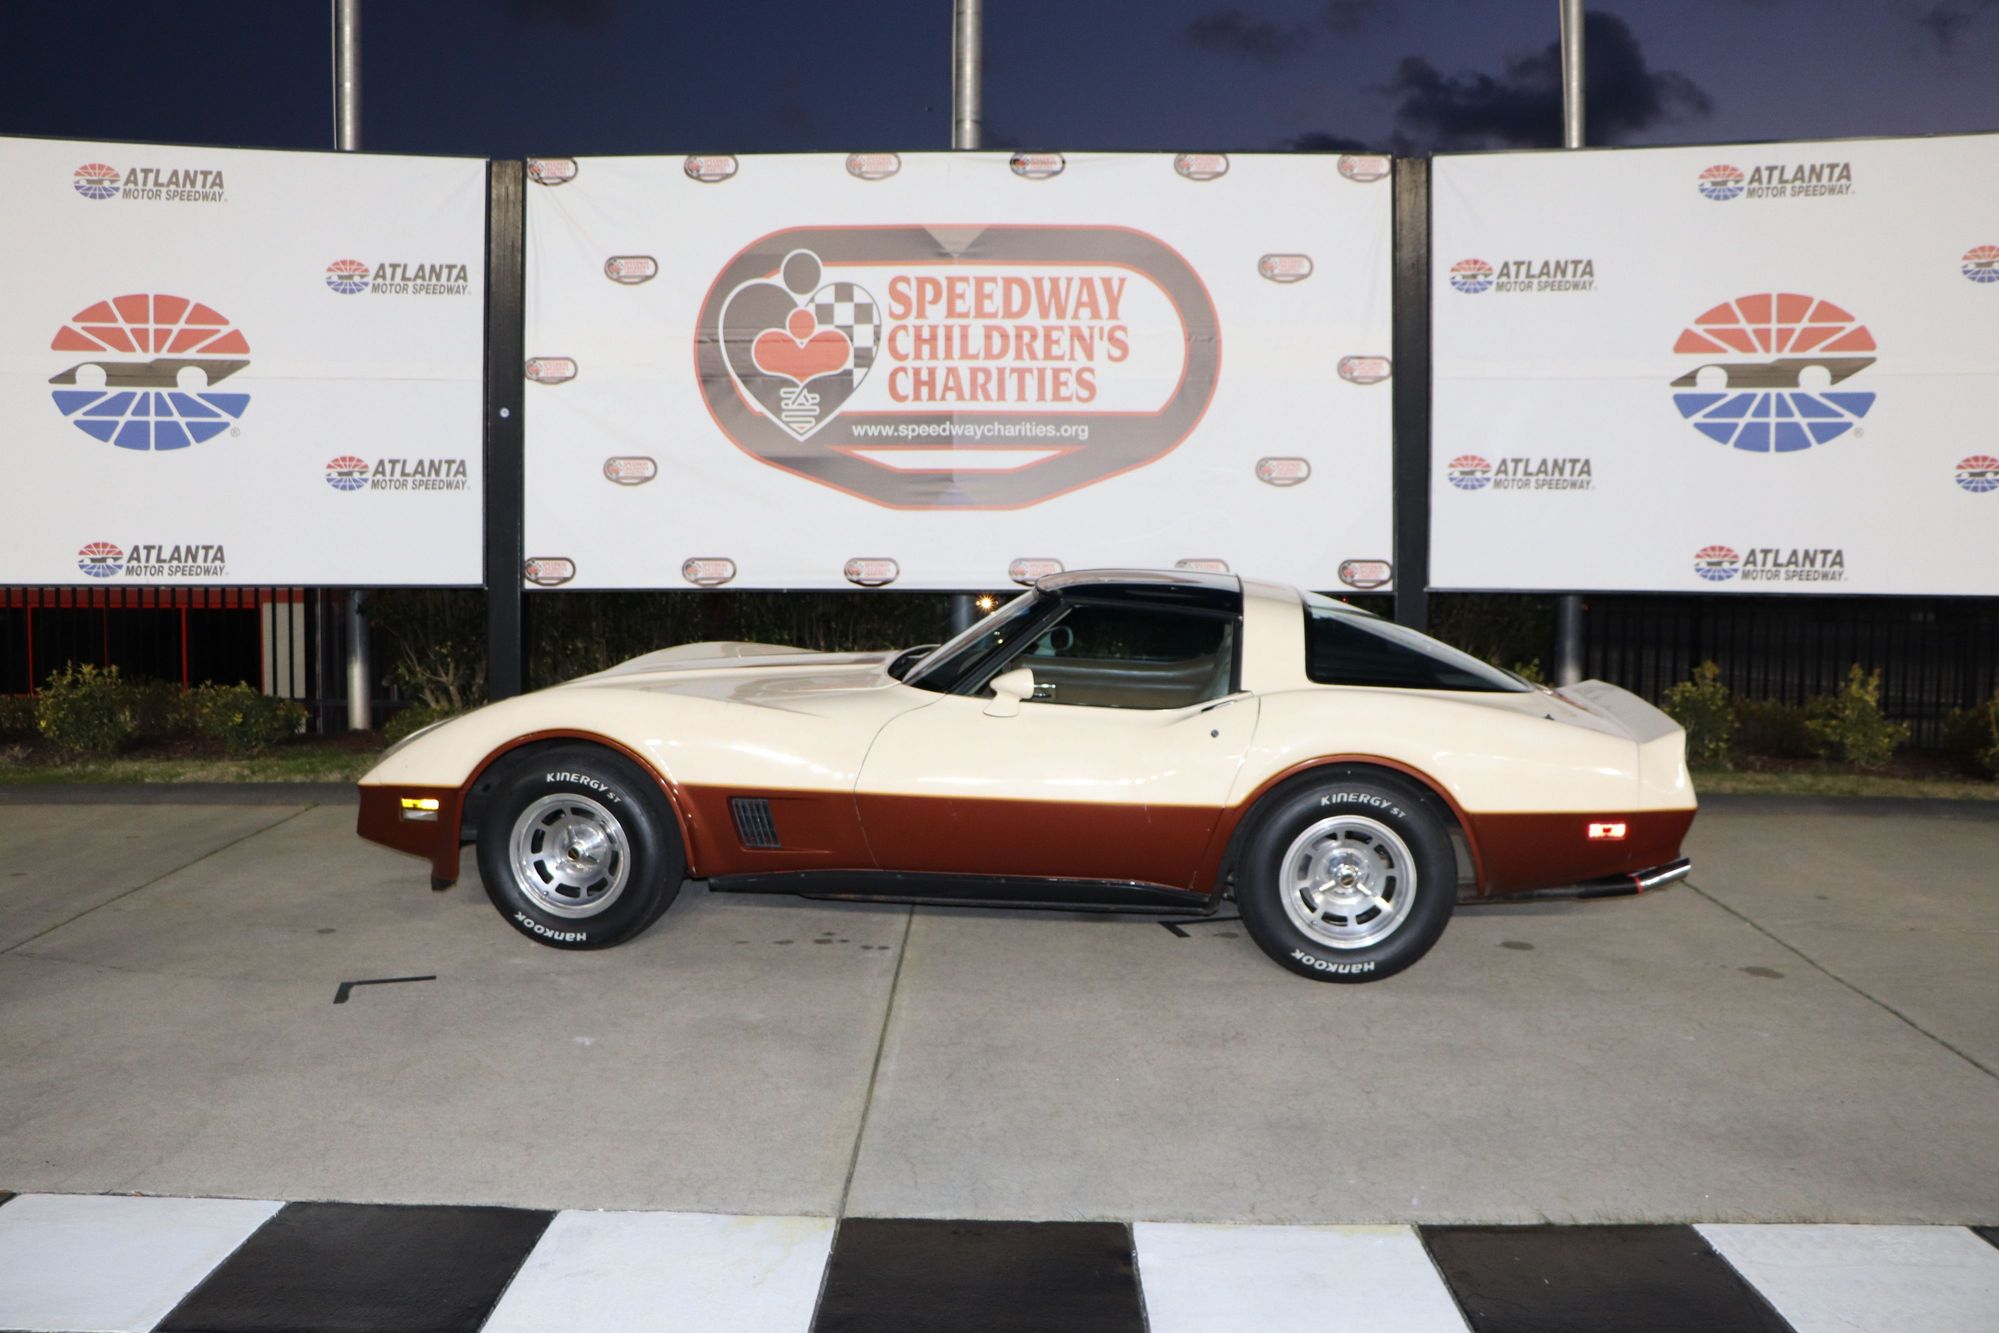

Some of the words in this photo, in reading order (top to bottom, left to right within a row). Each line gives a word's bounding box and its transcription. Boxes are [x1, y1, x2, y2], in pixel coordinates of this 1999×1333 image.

[123, 167, 224, 188] ATLANTA
[1748, 162, 1852, 185] ATLANTA
[122, 188, 162, 200] MOTOR
[165, 189, 224, 202] SPEEDWAY
[1746, 186, 1788, 198] MOTOR
[1791, 183, 1852, 196] SPEEDWAY
[372, 262, 469, 283] ATLANTA
[1497, 259, 1594, 280] ATLANTA
[371, 283, 407, 294] MOTOR
[412, 283, 468, 295] SPEEDWAY
[1495, 280, 1534, 292] MOTOR
[1537, 279, 1594, 292] SPEEDWAY
[888, 275, 1127, 321] SPEEDWAY
[888, 324, 1130, 363] CHILDREN'S
[888, 366, 1097, 403] CHARITIES
[852, 422, 1089, 440] www.speedwaycharities.org
[372, 458, 467, 478] ATLANTA
[1494, 458, 1592, 478] ATLANTA
[371, 479, 407, 491] MOTOR
[412, 479, 467, 491] SPEEDWAY
[1493, 478, 1531, 490] MOTOR
[1534, 478, 1592, 490] SPEEDWAY
[127, 545, 225, 564] ATLANTA
[1742, 548, 1845, 569] ATLANTA
[125, 565, 165, 577] MOTOR
[168, 565, 225, 577] SPEEDWAY
[1740, 568, 1782, 581] MOTOR
[1784, 569, 1845, 582] SPEEDWAY
[546, 772, 608, 791] KINERGY
[607, 792, 622, 803] ST
[1320, 792, 1392, 807] KINERGY
[1391, 807, 1407, 818] ST
